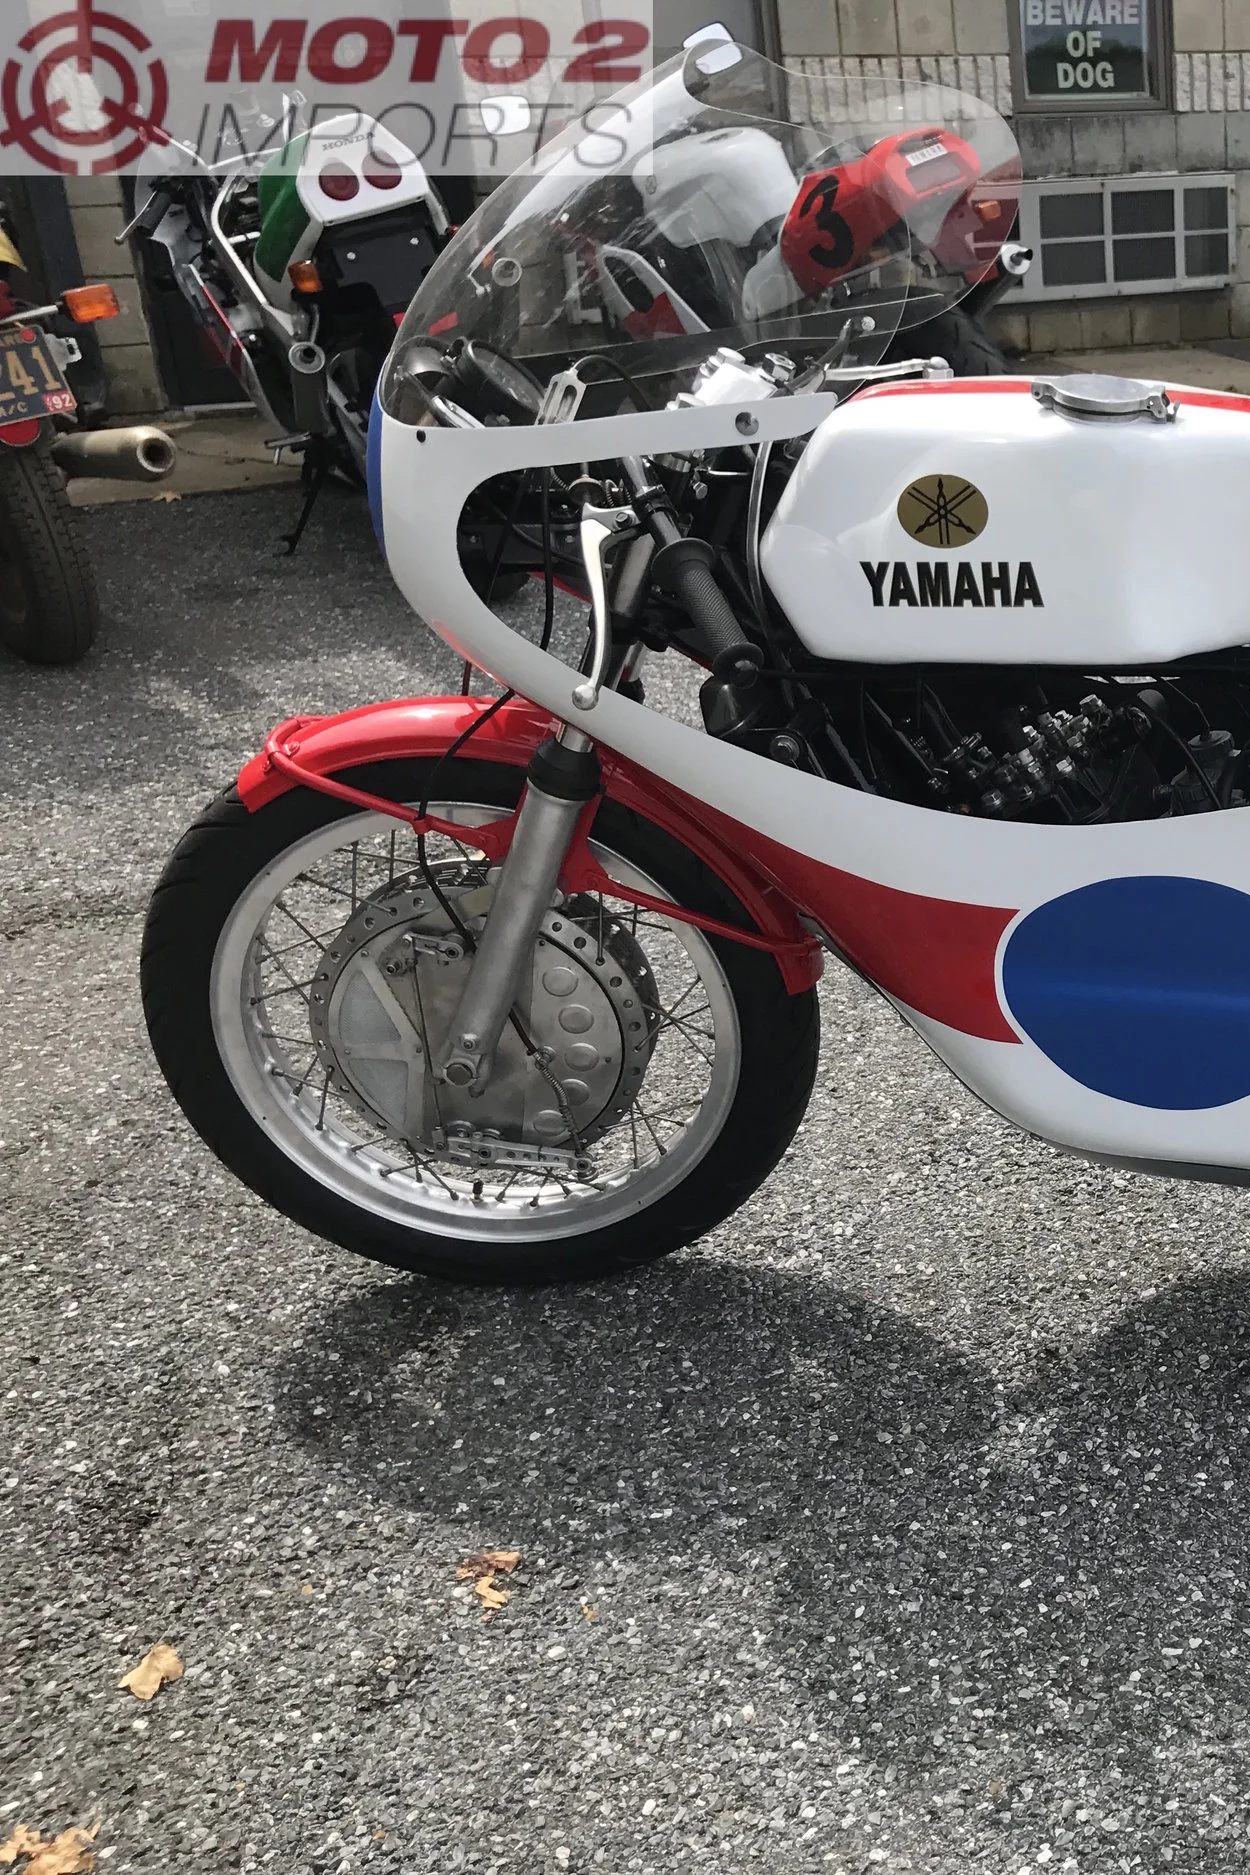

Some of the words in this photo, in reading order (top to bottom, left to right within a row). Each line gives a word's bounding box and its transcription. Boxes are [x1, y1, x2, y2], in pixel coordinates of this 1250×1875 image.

[1026, 0, 1140, 25] BEWARE
[1066, 30, 1102, 58] OF
[1056, 61, 1115, 88] DOG
[322, 131, 374, 151] HONDA
[799, 174, 854, 269] 3
[859, 561, 1045, 608] YAMAHA
